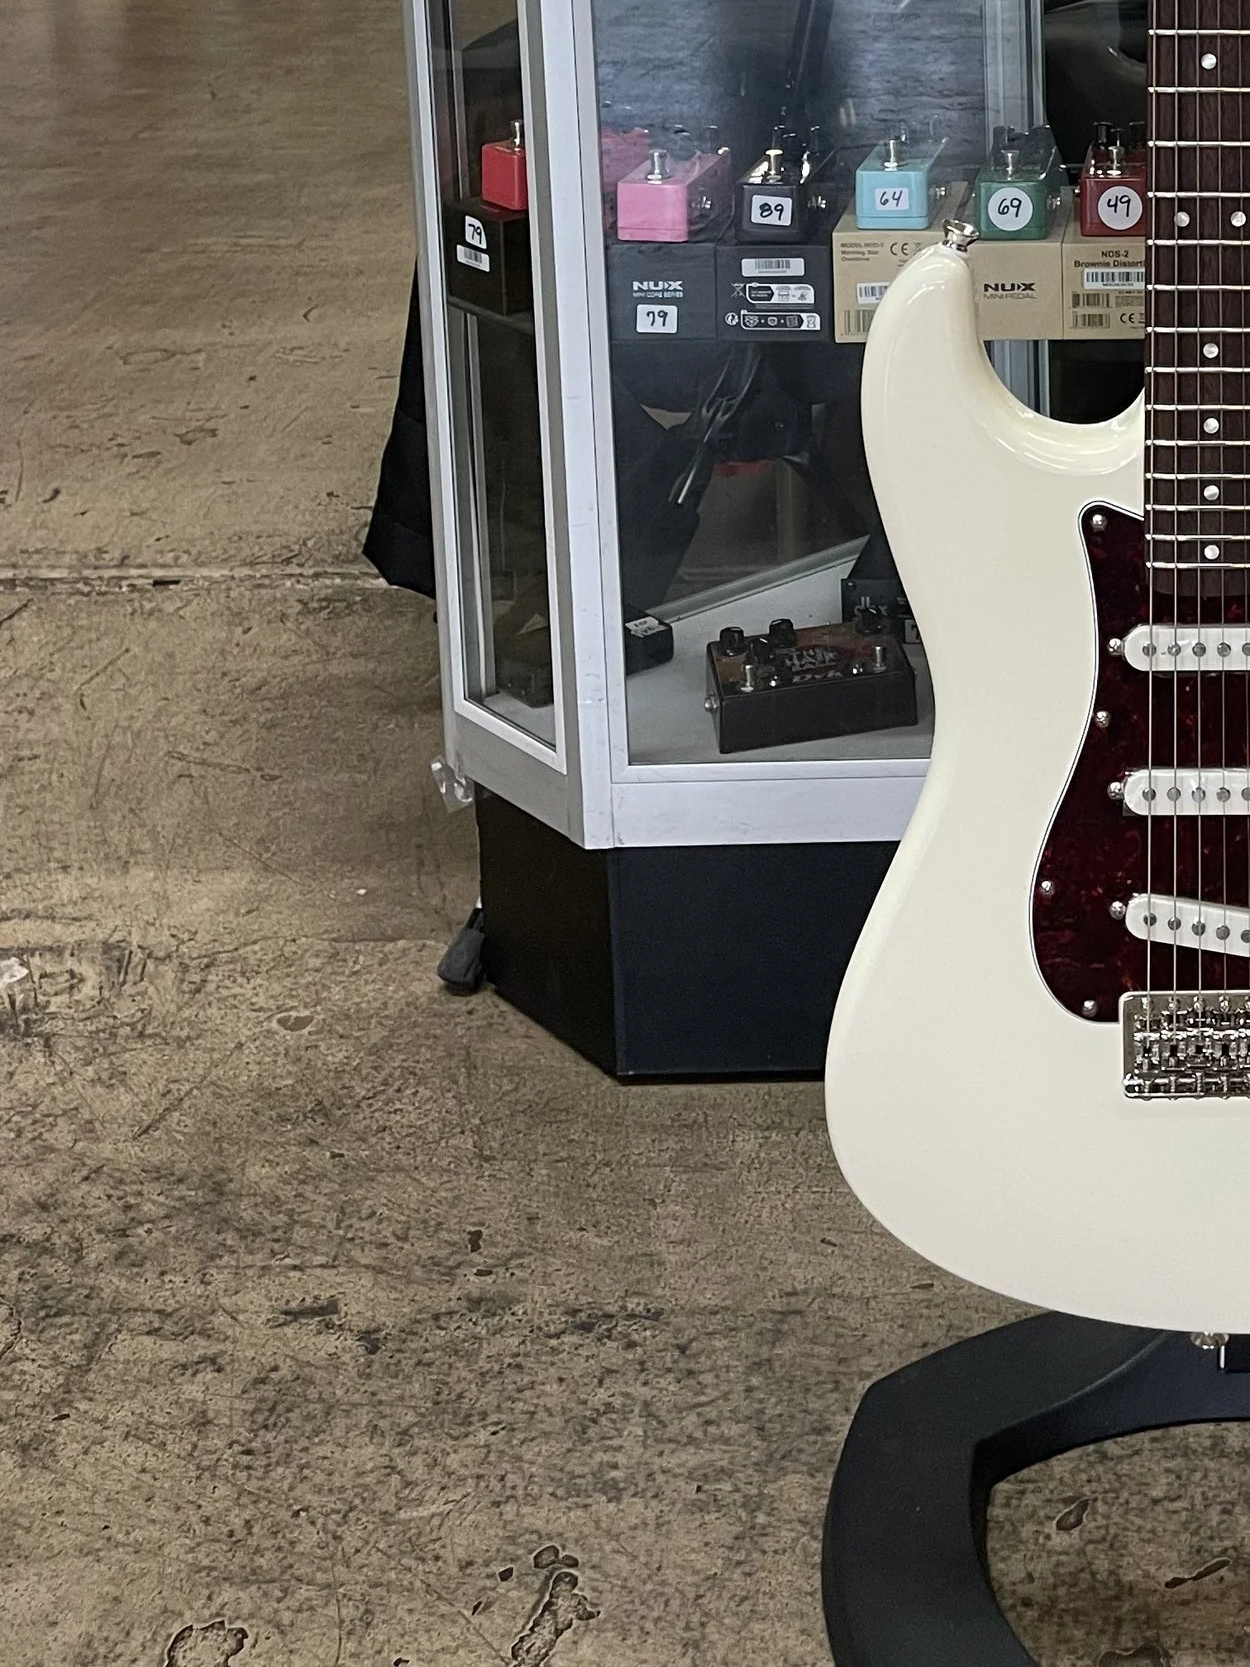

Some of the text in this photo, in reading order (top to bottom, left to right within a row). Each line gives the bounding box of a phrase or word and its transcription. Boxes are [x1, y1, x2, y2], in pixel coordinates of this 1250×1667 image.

[879, 189, 903, 208] 64
[997, 197, 1023, 218] 69
[1106, 194, 1132, 218] 49
[758, 202, 784, 222] 89
[468, 223, 483, 245] 79
[1101, 250, 1130, 258] NDS-2
[1074, 260, 1145, 268] Brownie Distort
[632, 280, 684, 291] NUX
[983, 282, 1036, 292] NUX
[646, 309, 669, 327] 79
